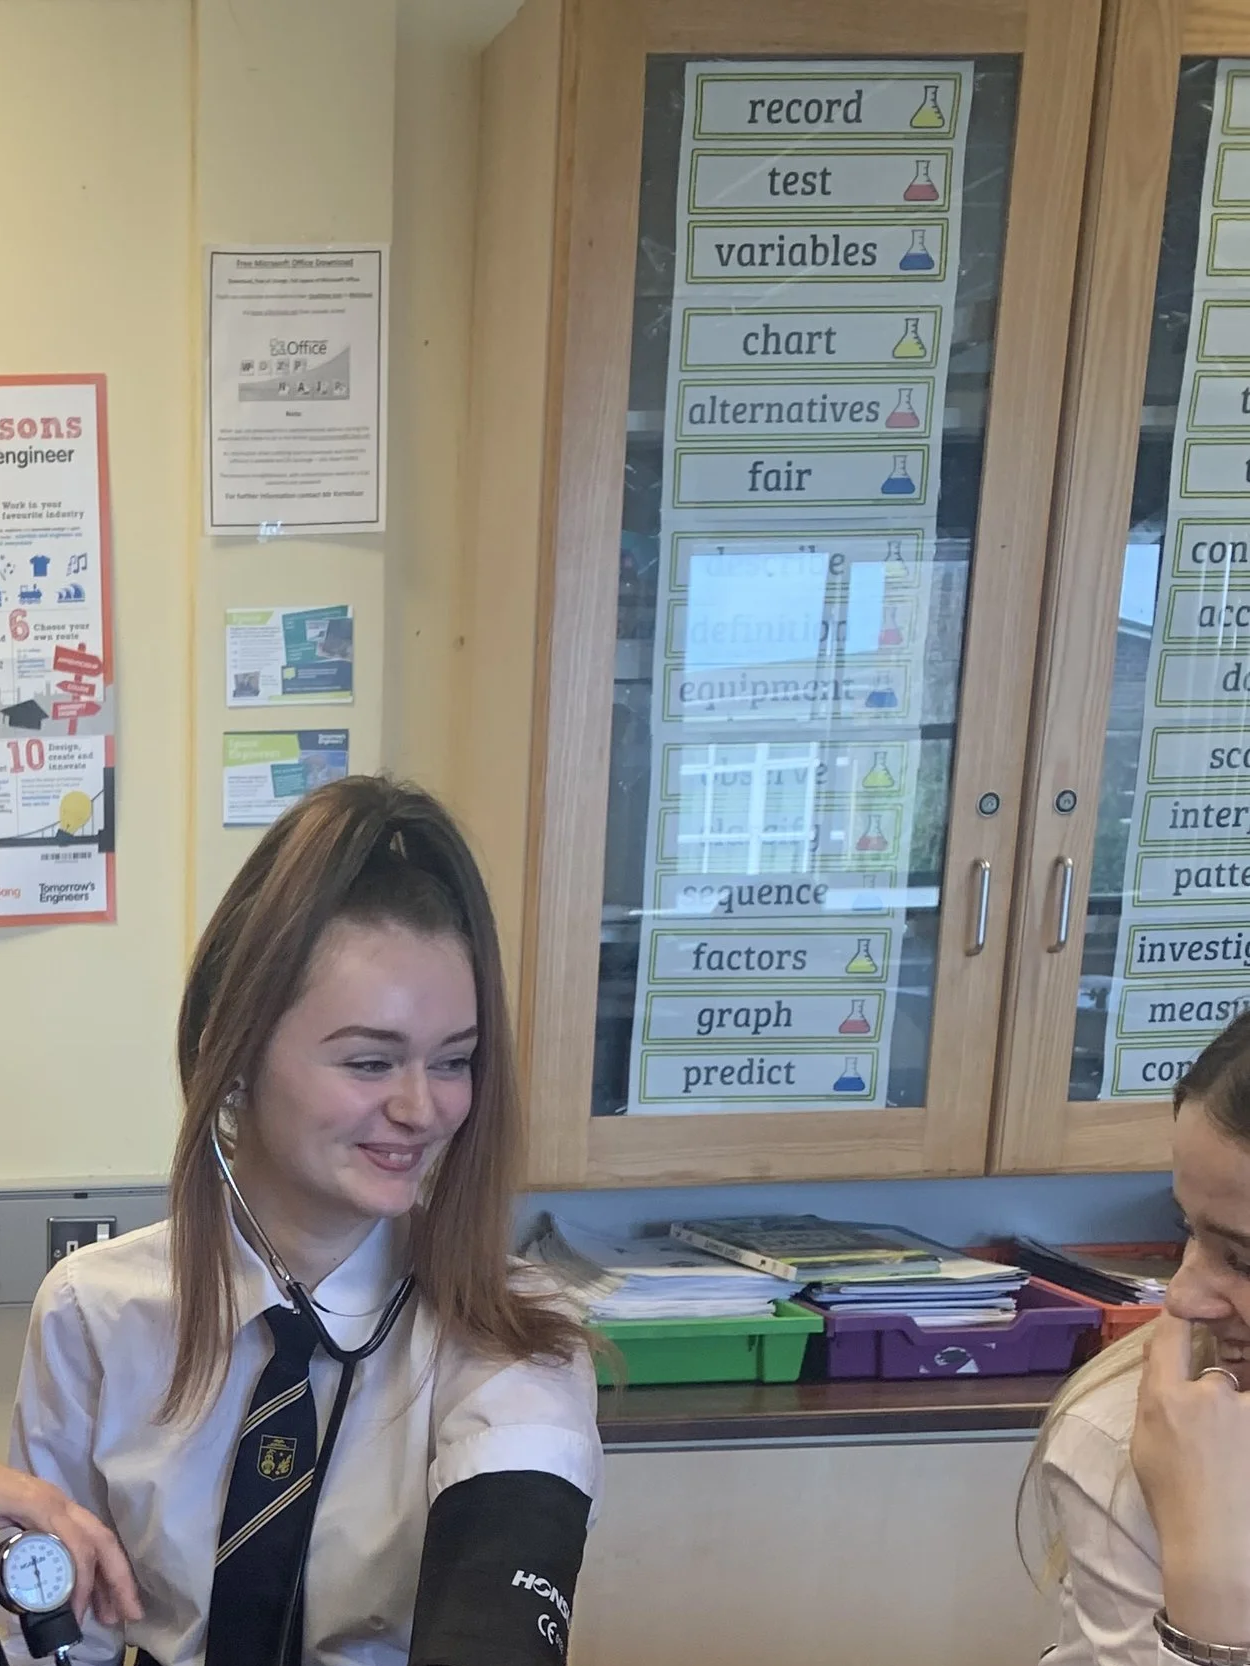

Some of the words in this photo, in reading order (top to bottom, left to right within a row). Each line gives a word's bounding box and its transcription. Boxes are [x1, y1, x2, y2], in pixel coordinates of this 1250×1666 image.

[748, 90, 863, 124] record
[767, 167, 832, 196] test
[715, 235, 877, 267] variables
[287, 341, 327, 355] Office
[743, 324, 836, 356] chart
[688, 393, 880, 425] alternatives
[748, 462, 811, 492] fair
[2, 502, 26, 510] Work
[41, 501, 62, 510] your
[2, 511, 43, 520] favourite
[45, 510, 85, 519] industry
[9, 608, 30, 641] 6
[7, 739, 45, 774] 10
[39, 882, 95, 893] Tomorrow's
[39, 893, 89, 904] Engineers
[683, 882, 829, 914] sequence
[693, 942, 807, 971] factors
[697, 1001, 793, 1035] graph
[683, 1059, 795, 1092] predict
